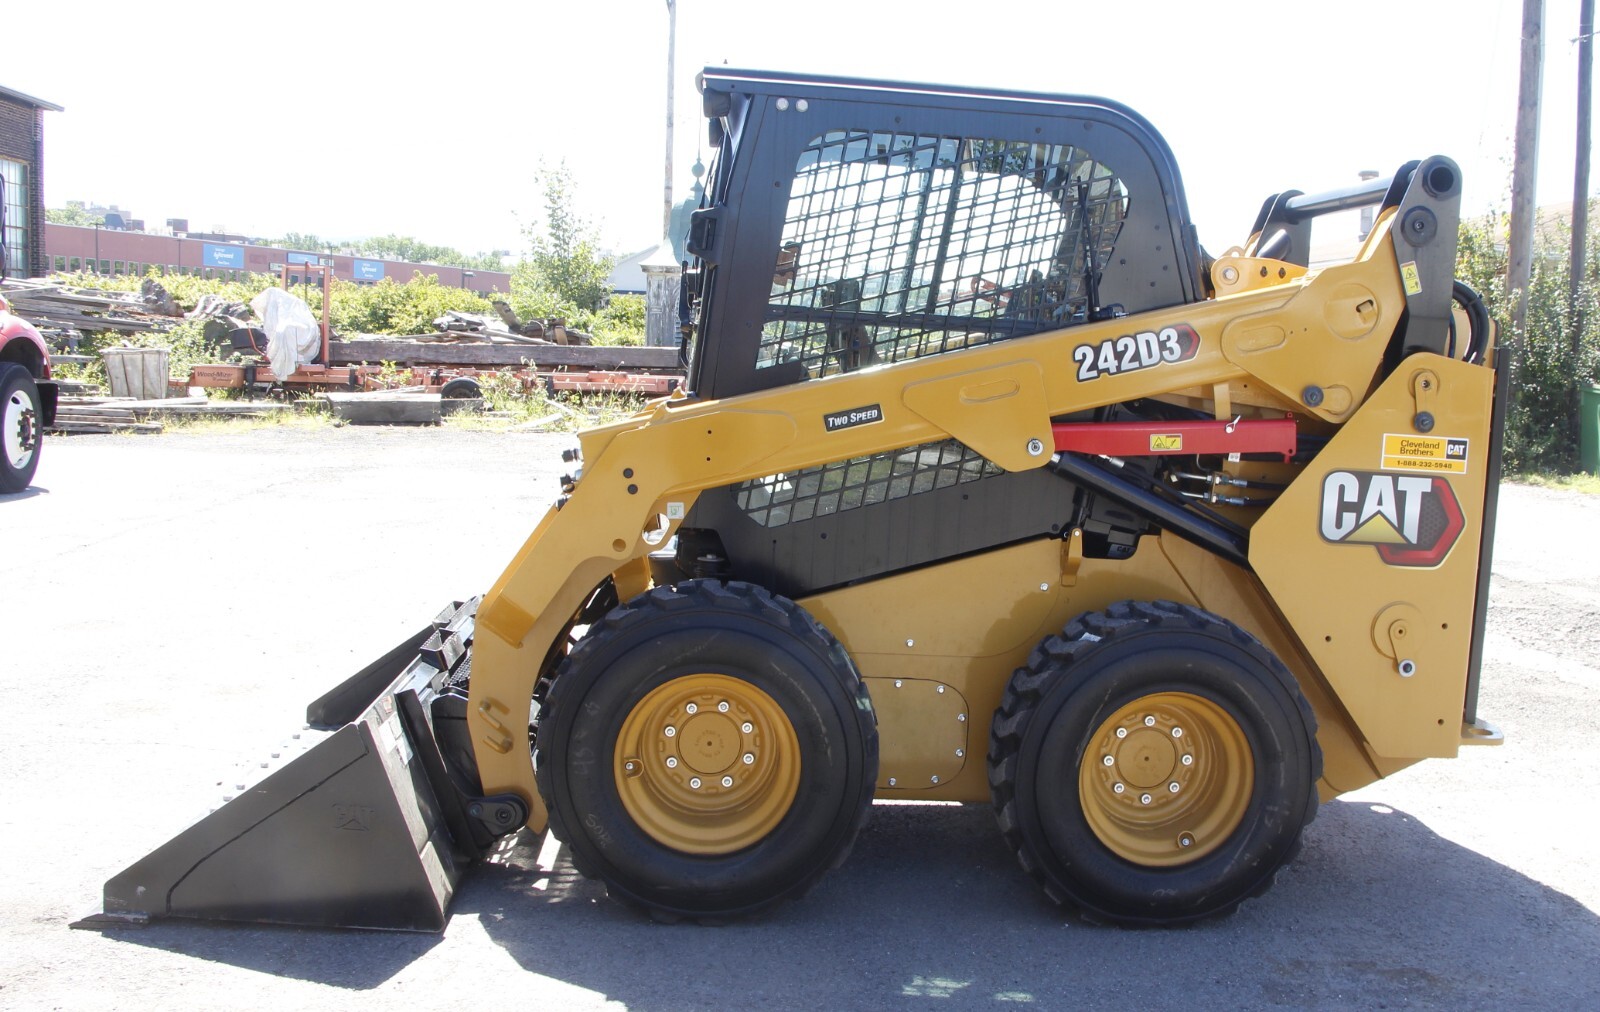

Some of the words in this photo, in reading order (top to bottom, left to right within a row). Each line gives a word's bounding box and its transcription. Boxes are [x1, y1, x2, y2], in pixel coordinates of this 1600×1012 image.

[1074, 327, 1181, 380] 242D3
[828, 416, 848, 428] TWO
[850, 409, 878, 423] SPEED
[1399, 447, 1434, 456] Brothers
[1400, 440, 1440, 449] Cleveland
[1447, 444, 1465, 456] CAT
[1321, 471, 1432, 544] CAT
